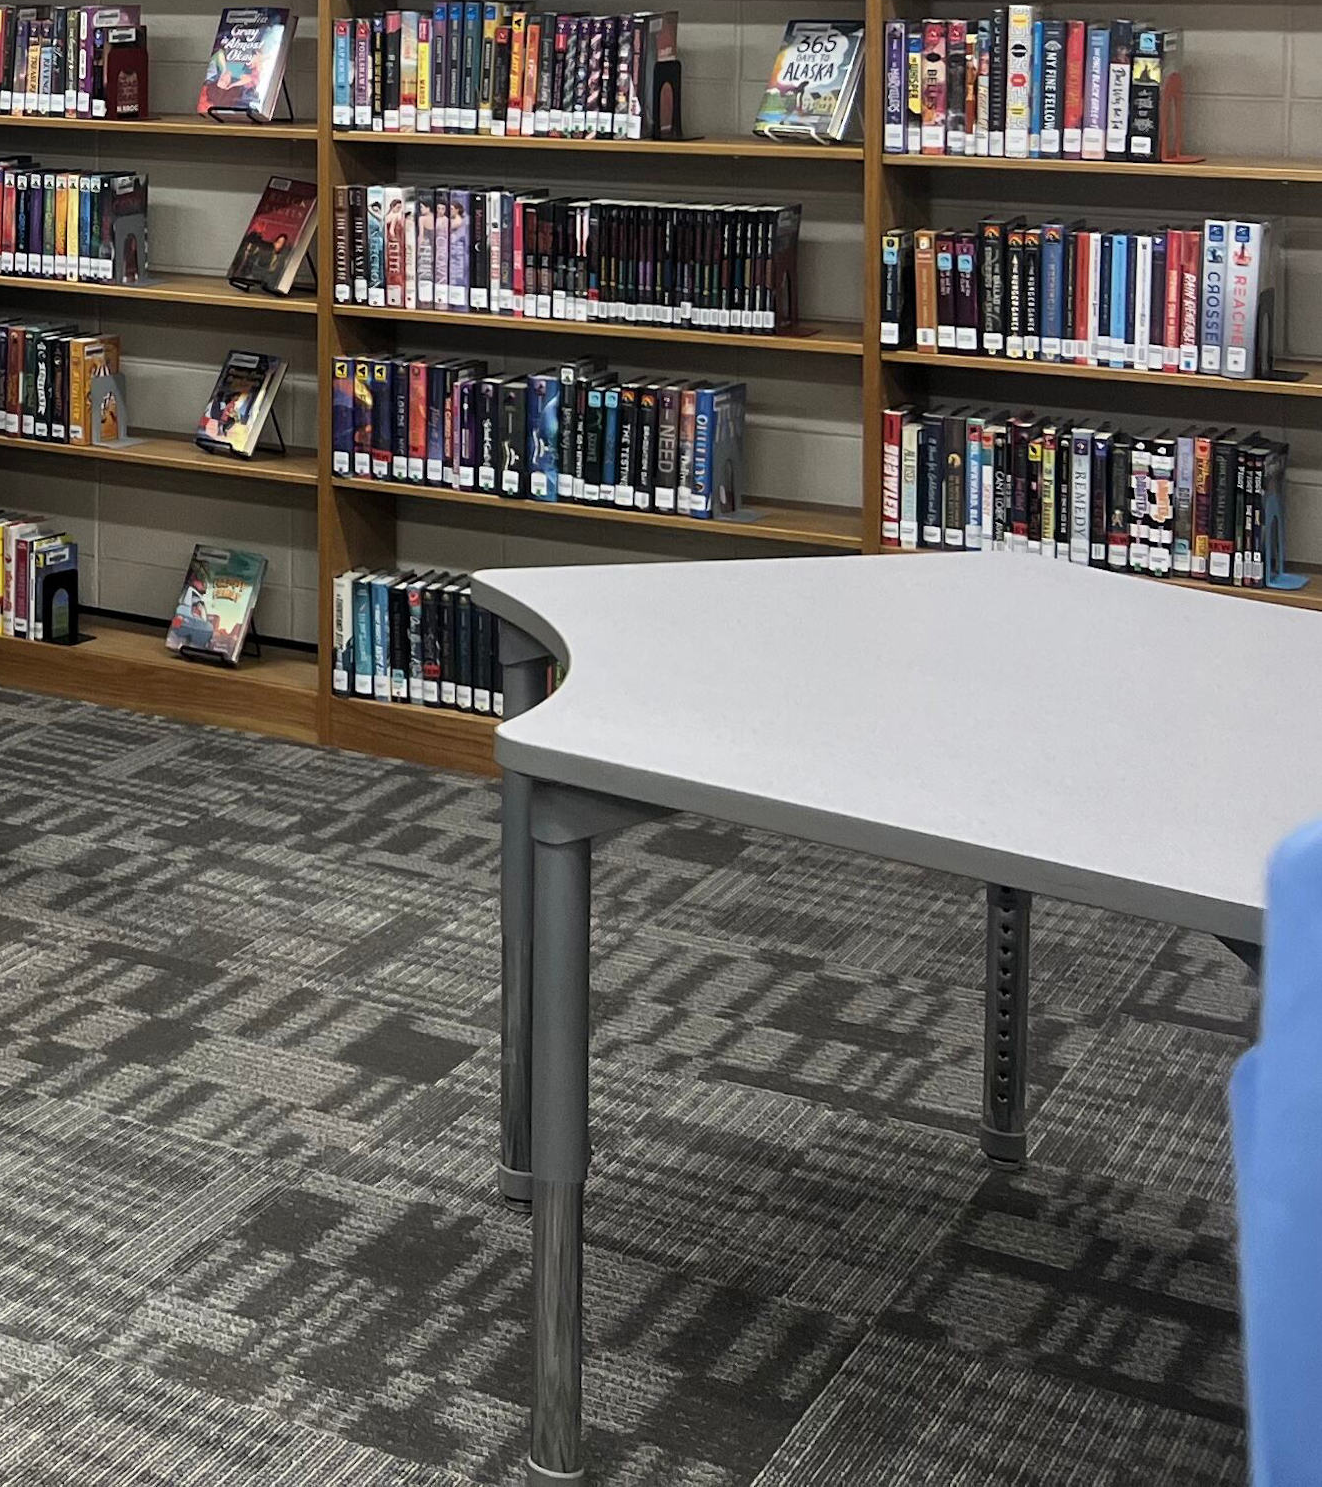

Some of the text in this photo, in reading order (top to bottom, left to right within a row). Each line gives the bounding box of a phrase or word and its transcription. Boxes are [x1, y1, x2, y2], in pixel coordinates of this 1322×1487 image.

[231, 24, 260, 42] Gray
[225, 38, 265, 51] Almost
[797, 33, 838, 53] 365
[227, 50, 253, 66] Okay
[1044, 52, 1058, 68] MY
[782, 62, 834, 81] ALASKA
[1044, 69, 1058, 91] FINE
[926, 69, 938, 110] BELLES
[1232, 276, 1247, 345] REACHE
[657, 424, 675, 473] NEED
[1074, 471, 1086, 538] REMEDY
[995, 522, 1003, 541] AWA
